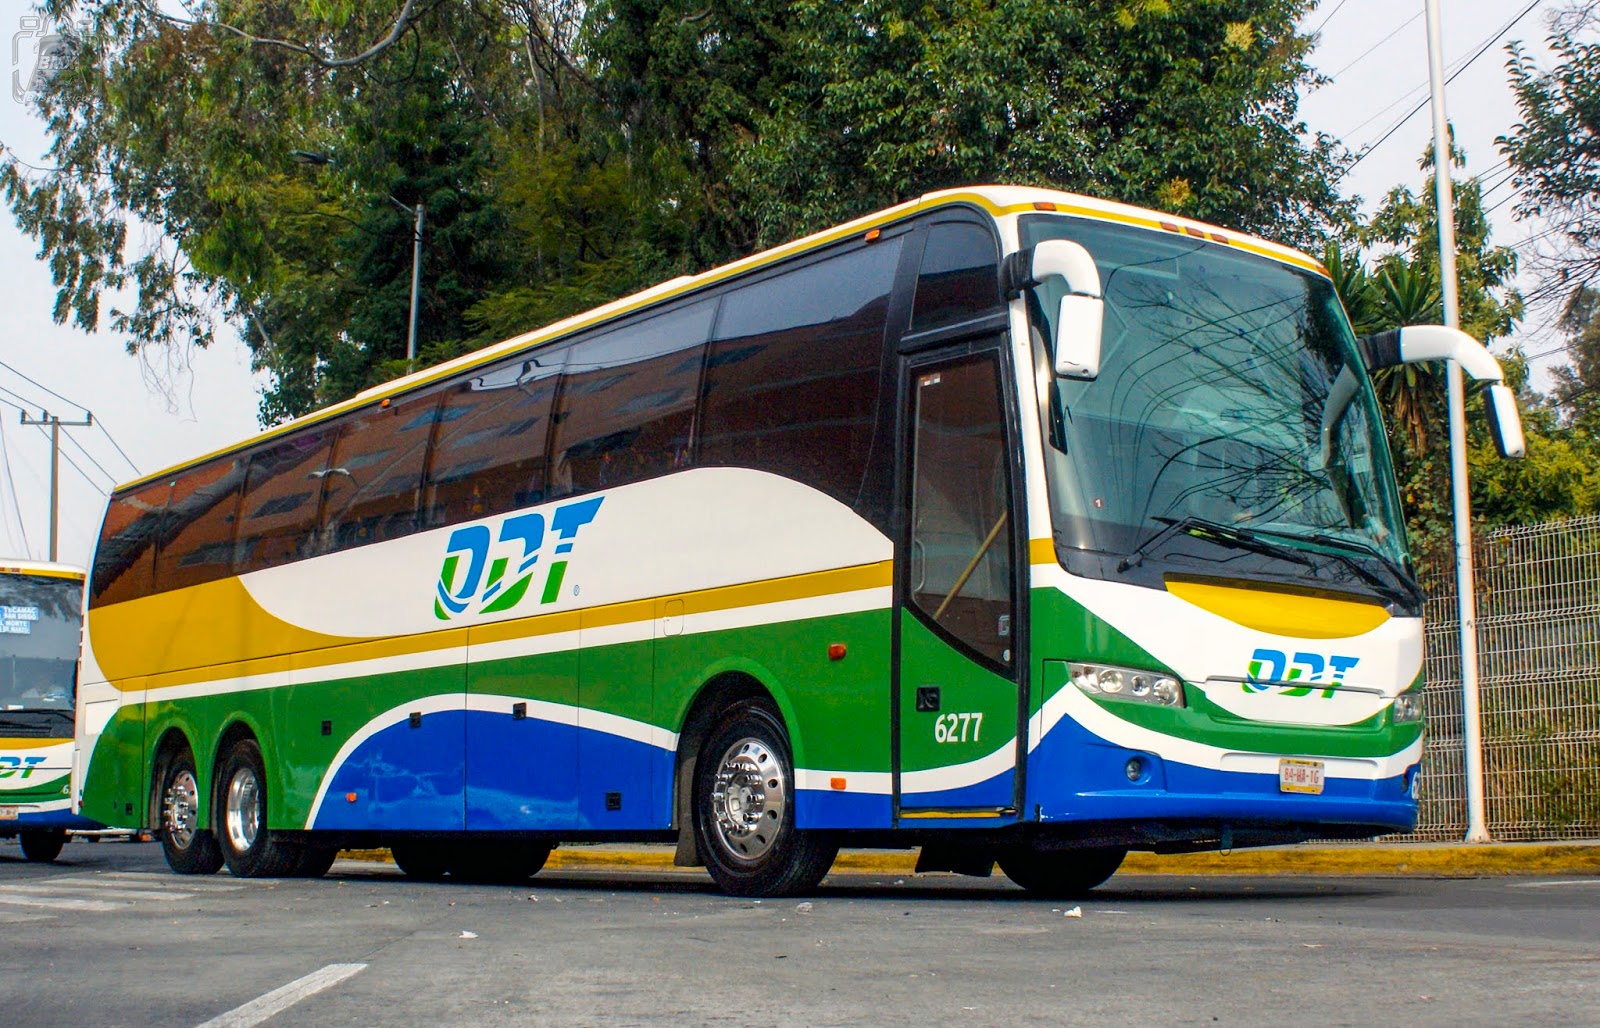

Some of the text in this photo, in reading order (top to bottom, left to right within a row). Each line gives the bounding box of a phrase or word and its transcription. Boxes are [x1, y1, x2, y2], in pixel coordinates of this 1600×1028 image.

[434, 496, 605, 620] ODT
[1242, 648, 1360, 699] ODT
[934, 712, 983, 743] 6277
